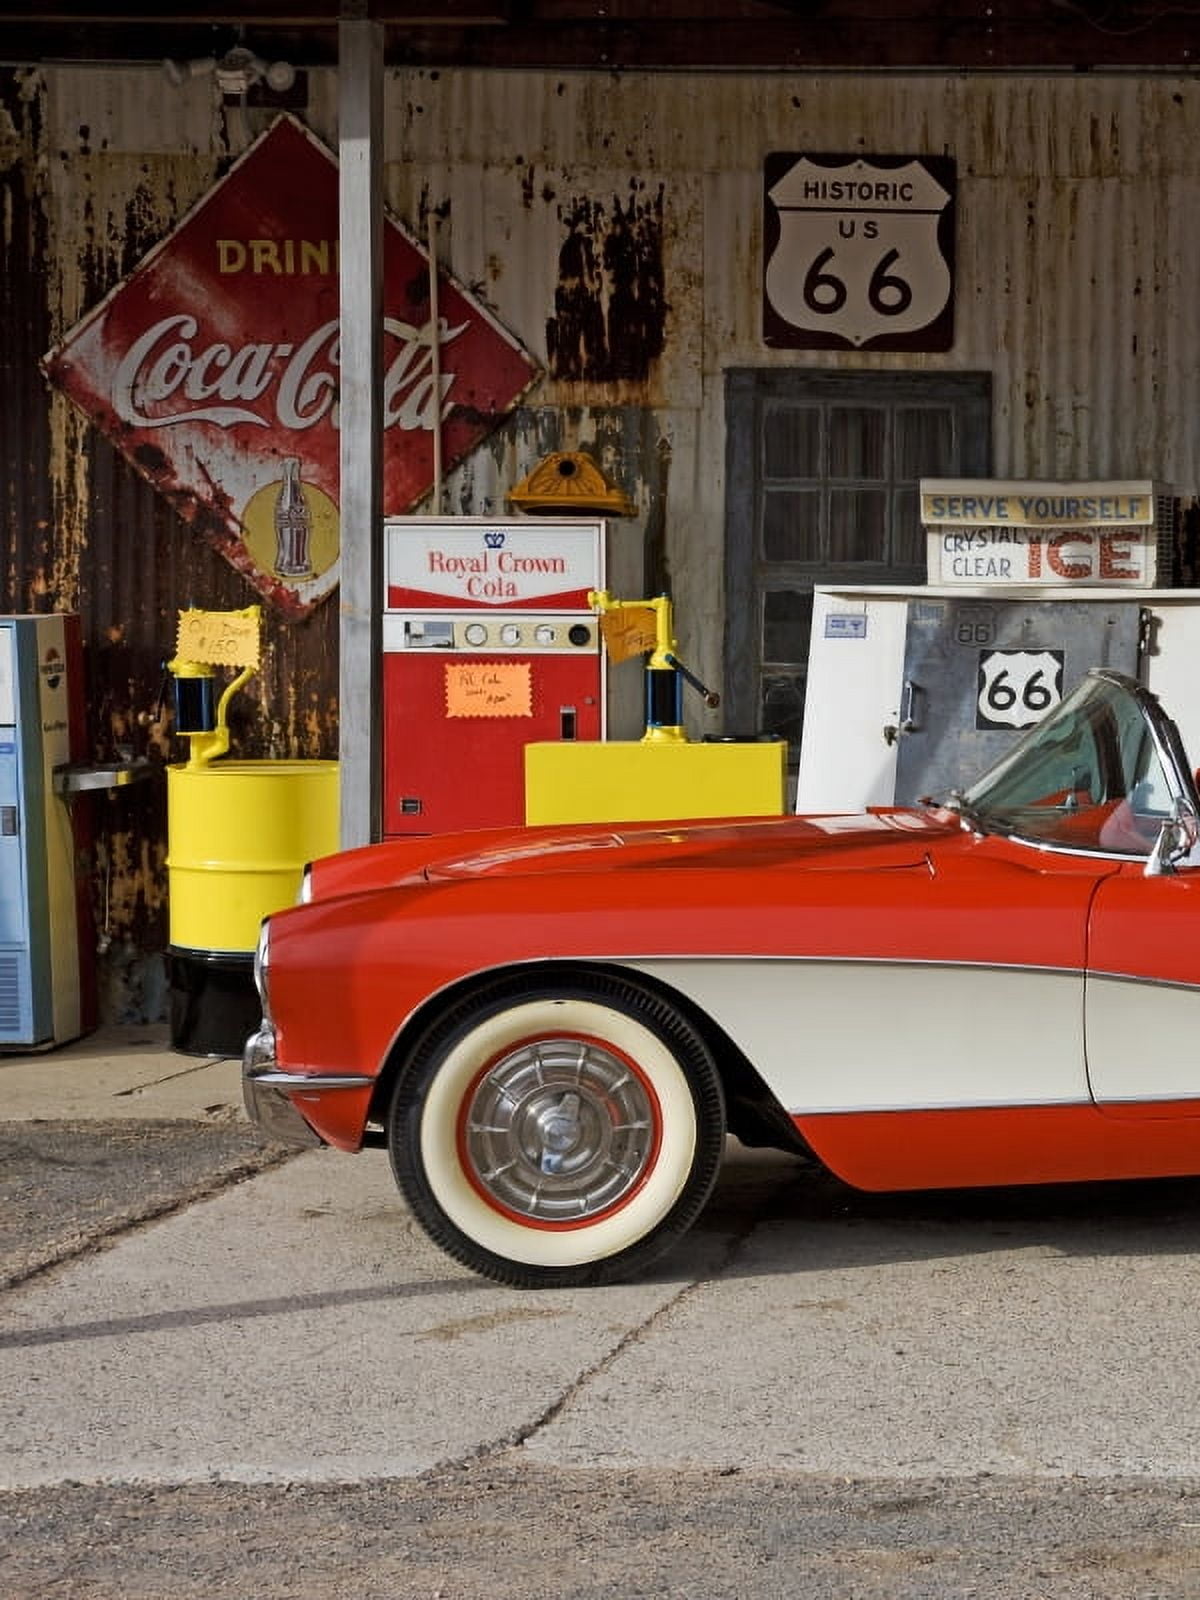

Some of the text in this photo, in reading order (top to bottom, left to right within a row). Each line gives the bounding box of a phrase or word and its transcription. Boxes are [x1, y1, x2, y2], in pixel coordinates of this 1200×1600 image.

[804, 181, 913, 202] HISTORIC
[217, 239, 340, 275] DRIN
[803, 246, 912, 316] 66
[112, 314, 471, 432] Coca-Cla
[931, 497, 1142, 519] SERVE YOURSELF
[943, 526, 1024, 553] CRYSTAL
[428, 550, 566, 578] Royal Crown
[953, 557, 1012, 578] CLEAR
[1028, 531, 1142, 580] ICE
[466, 576, 519, 597] Cola
[988, 669, 1052, 711] 66
